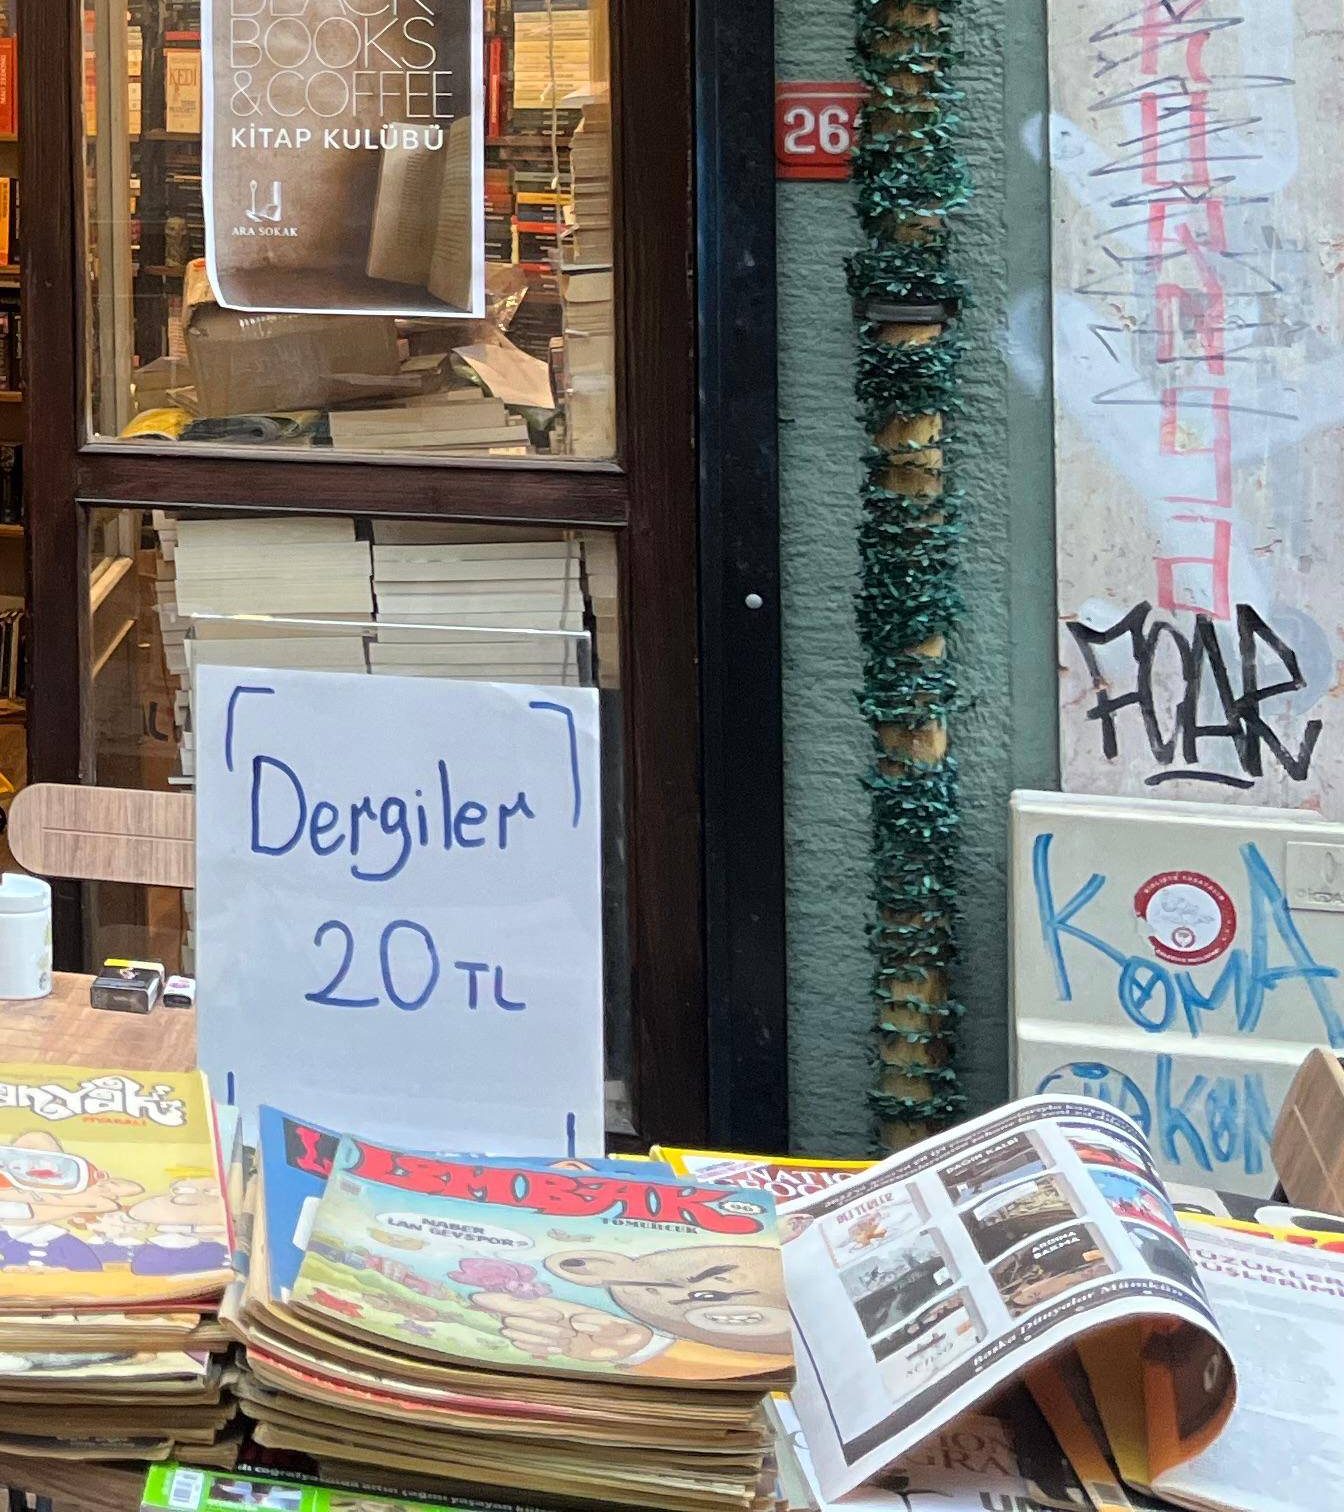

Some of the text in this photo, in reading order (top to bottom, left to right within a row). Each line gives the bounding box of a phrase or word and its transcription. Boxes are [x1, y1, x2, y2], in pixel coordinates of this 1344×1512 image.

[230, 17, 436, 70] BOOKS
[231, 123, 443, 150] KİTAP KULÜBÜ
[784, 106, 863, 155] 26
[231, 226, 298, 238] ARA SOKAK
[251, 755, 535, 881] Dergiler
[305, 920, 527, 1010] 20 TL
[388, 1217, 422, 1232] LAN
[421, 1217, 485, 1234] NABER
